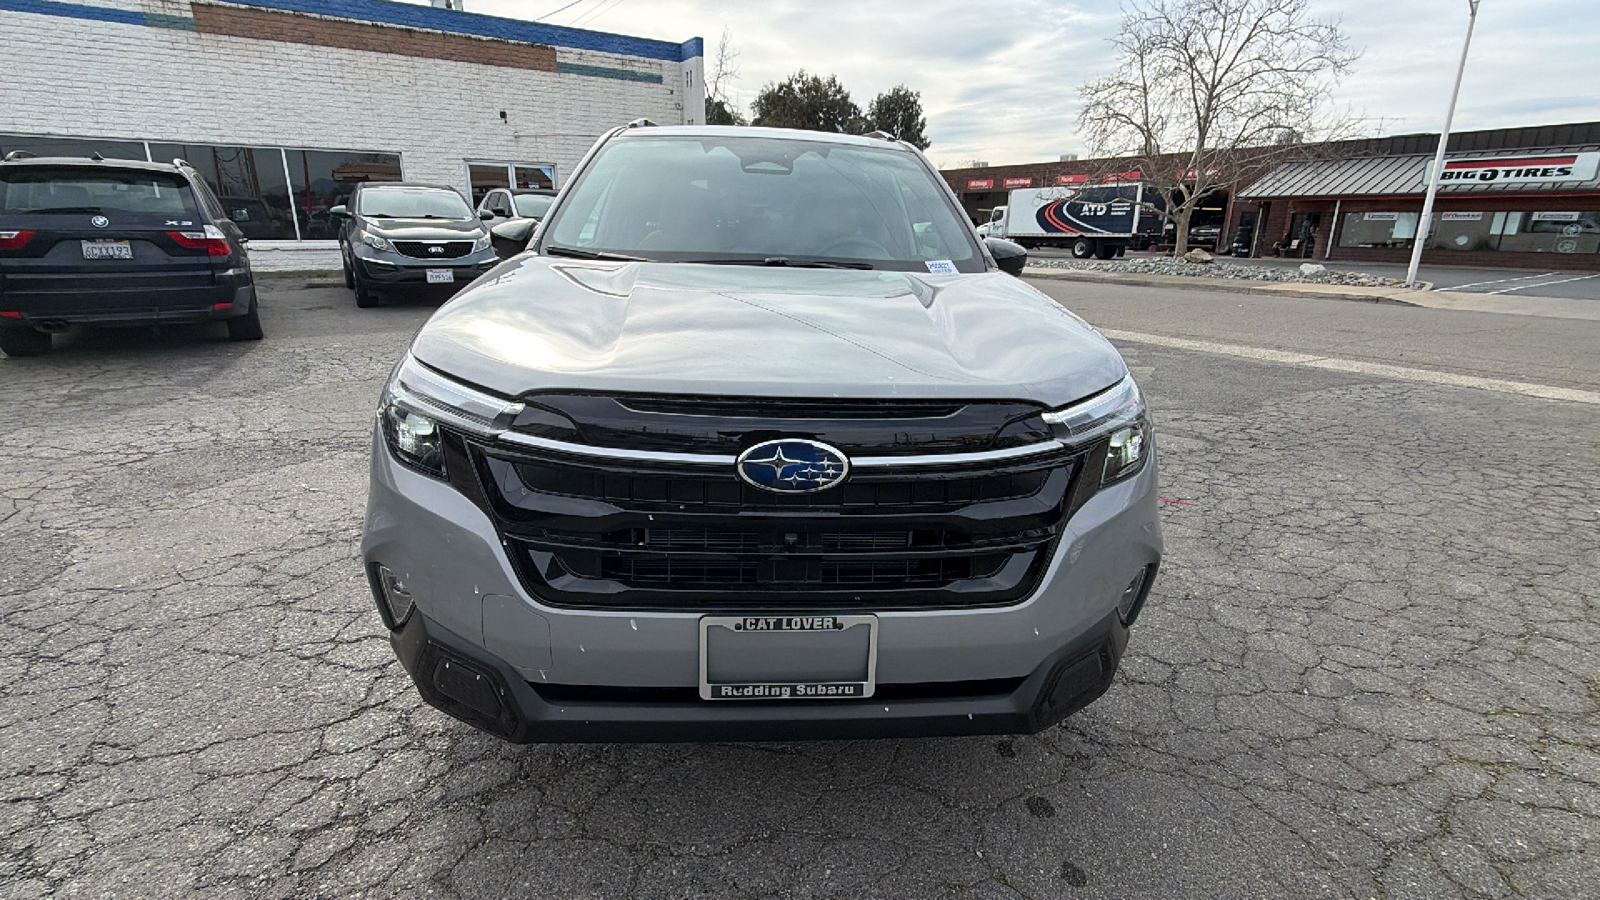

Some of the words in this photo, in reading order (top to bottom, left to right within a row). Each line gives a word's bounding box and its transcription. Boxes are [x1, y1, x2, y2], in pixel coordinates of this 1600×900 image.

[1440, 170, 1478, 180] BIG
[1501, 166, 1574, 178] TIRES
[1080, 203, 1107, 216] ATD
[85, 246, 130, 256] 6CXX193
[745, 618, 777, 630] CAT
[782, 617, 834, 630] LOVER
[721, 685, 791, 698] Redding
[796, 684, 854, 696] Subaru
